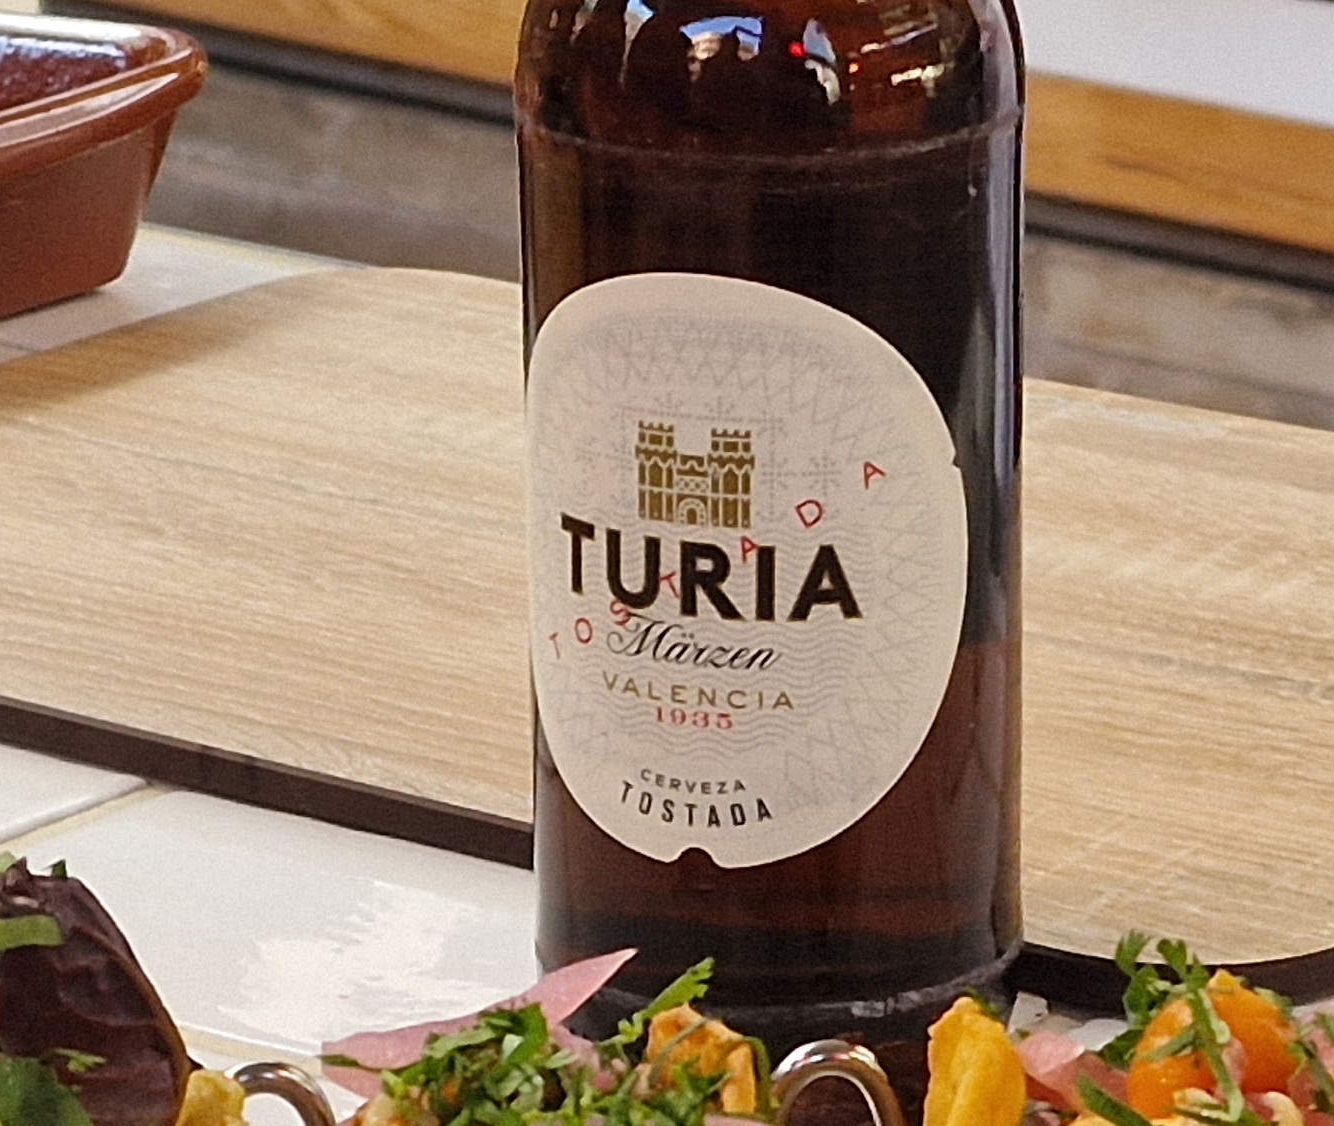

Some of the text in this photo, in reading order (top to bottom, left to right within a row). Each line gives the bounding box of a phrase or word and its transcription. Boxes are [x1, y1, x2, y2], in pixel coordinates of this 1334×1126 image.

[560, 511, 863, 623] TURIA
[606, 612, 782, 671] Märzen
[601, 670, 795, 711] VALENCIA
[653, 706, 735, 731] 1935
[639, 768, 747, 794] CERVEZA
[618, 779, 774, 829] TOSTADA
